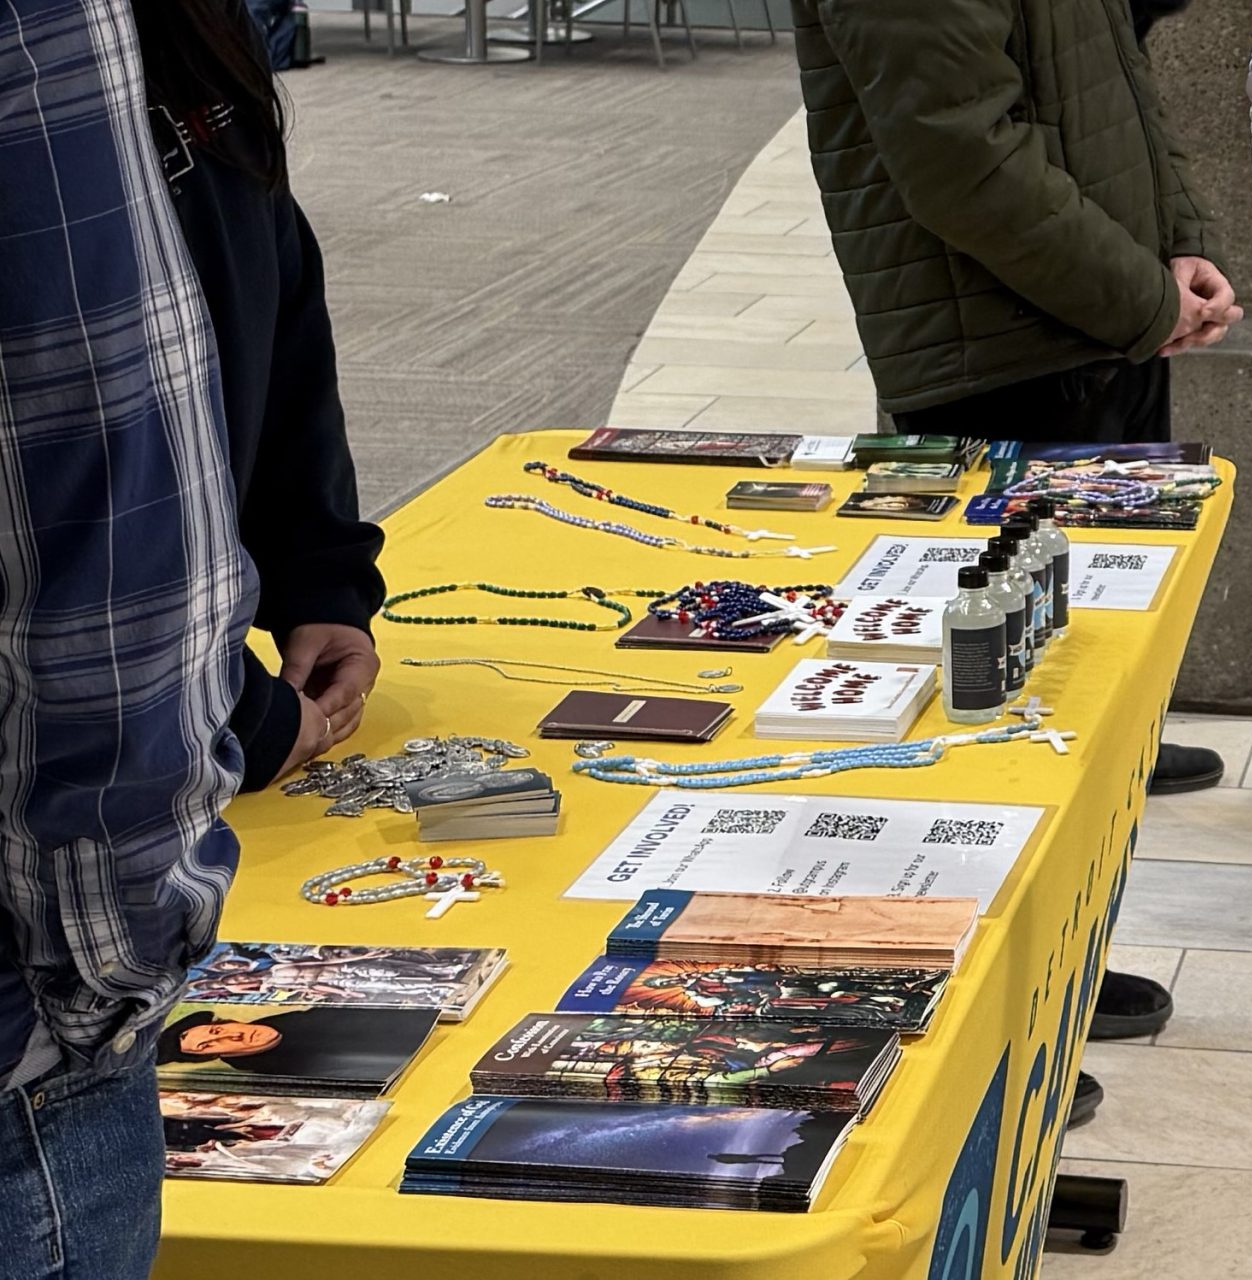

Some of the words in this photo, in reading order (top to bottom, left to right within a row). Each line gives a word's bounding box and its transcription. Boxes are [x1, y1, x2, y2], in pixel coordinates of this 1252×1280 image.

[853, 598, 909, 641] WELCOME
[890, 606, 933, 635] HOME
[791, 662, 859, 712] WELCOME
[831, 673, 883, 705] HOME
[606, 860, 640, 883] GET
[626, 803, 696, 858] INVOLVED!
[821, 862, 851, 888] Instagram
[1028, 810, 1118, 1041] DETROIT
[574, 982, 597, 997] How
[605, 967, 636, 985] Rosary
[494, 1020, 551, 1062] Confession
[424, 1116, 468, 1154] Existence
